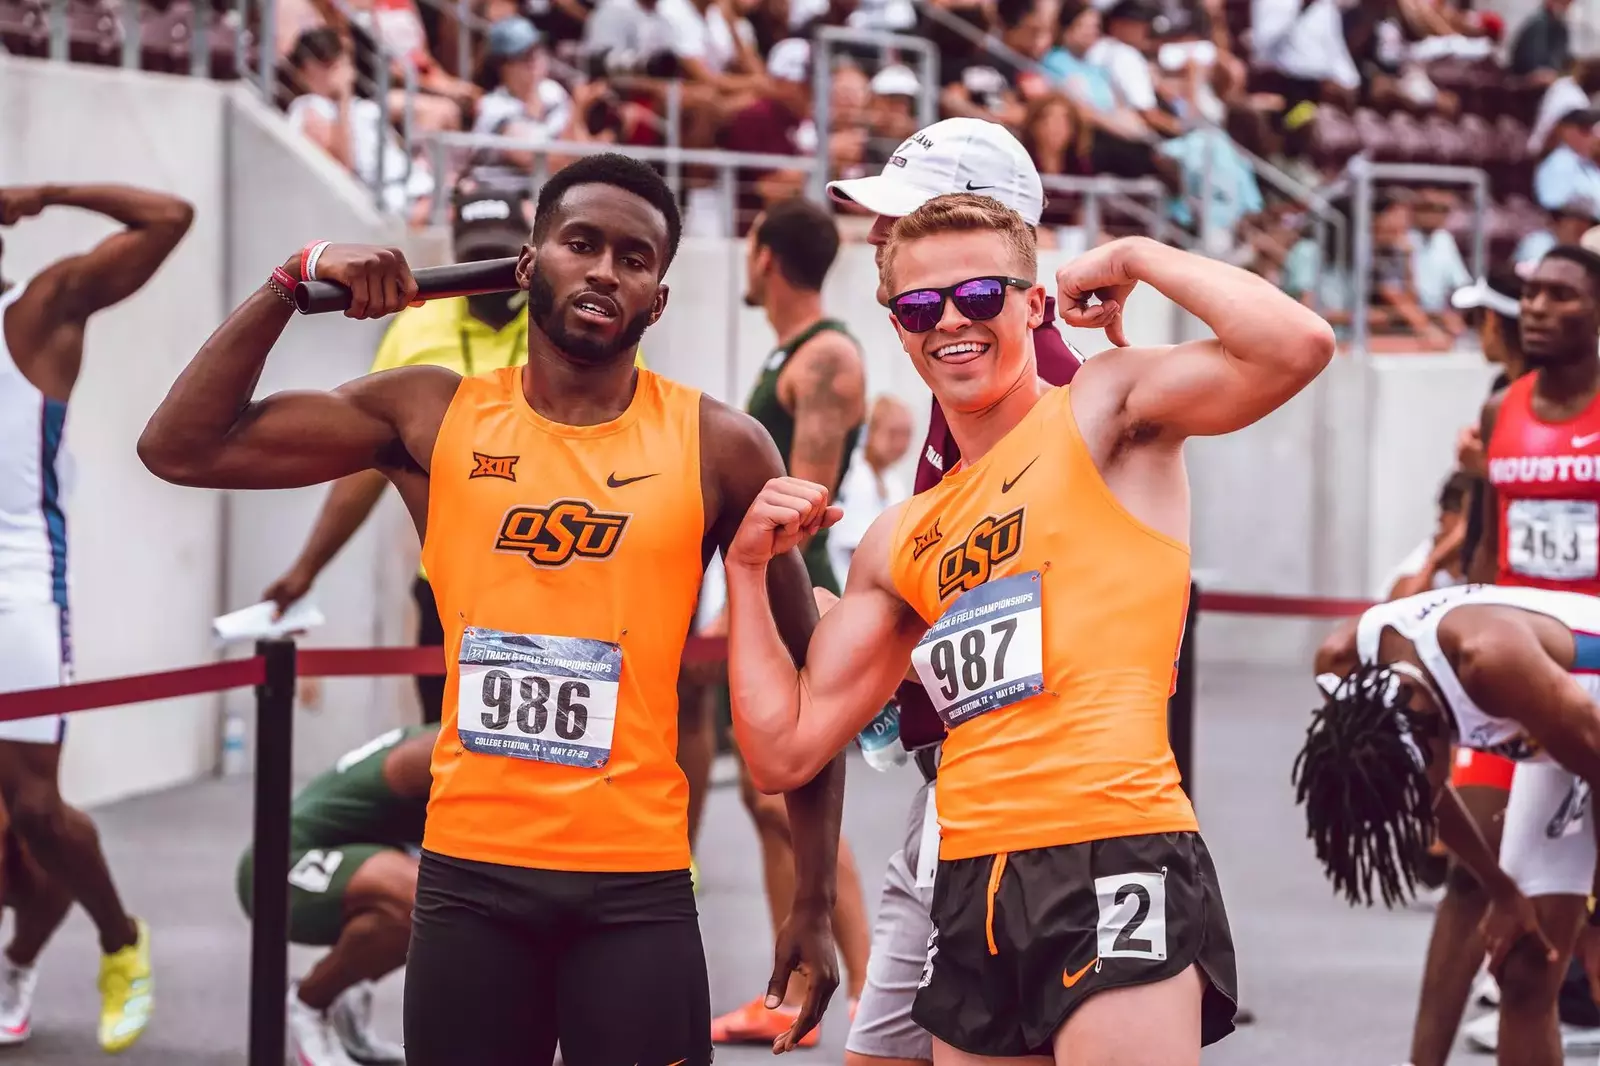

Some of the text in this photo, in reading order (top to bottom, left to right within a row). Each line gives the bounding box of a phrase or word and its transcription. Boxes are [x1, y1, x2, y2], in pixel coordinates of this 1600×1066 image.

[468, 451, 520, 482] XII
[1490, 455, 1600, 484] HOUSTO
[495, 500, 629, 566] OSU
[1520, 525, 1579, 562] 463
[939, 507, 1025, 601] OSU
[931, 620, 951, 634] TRACK
[956, 611, 974, 625] FIELD
[974, 592, 1034, 617] CHAMPIONSHIPS
[485, 650, 613, 673] TRACK & FIELD CHAMPIONSHIPS
[930, 617, 1019, 701] 987
[480, 669, 591, 741] 986
[961, 698, 981, 716] STATION,
[981, 696, 989, 704] TX
[996, 688, 1009, 699] MAY
[1008, 683, 1025, 694] 27-29
[474, 736, 502, 748] COLLEGE
[502, 739, 531, 752] STATION,
[532, 743, 541, 752] TX
[550, 746, 567, 756] MAY
[566, 748, 589, 759] 27-29
[1112, 883, 1152, 953] 2
